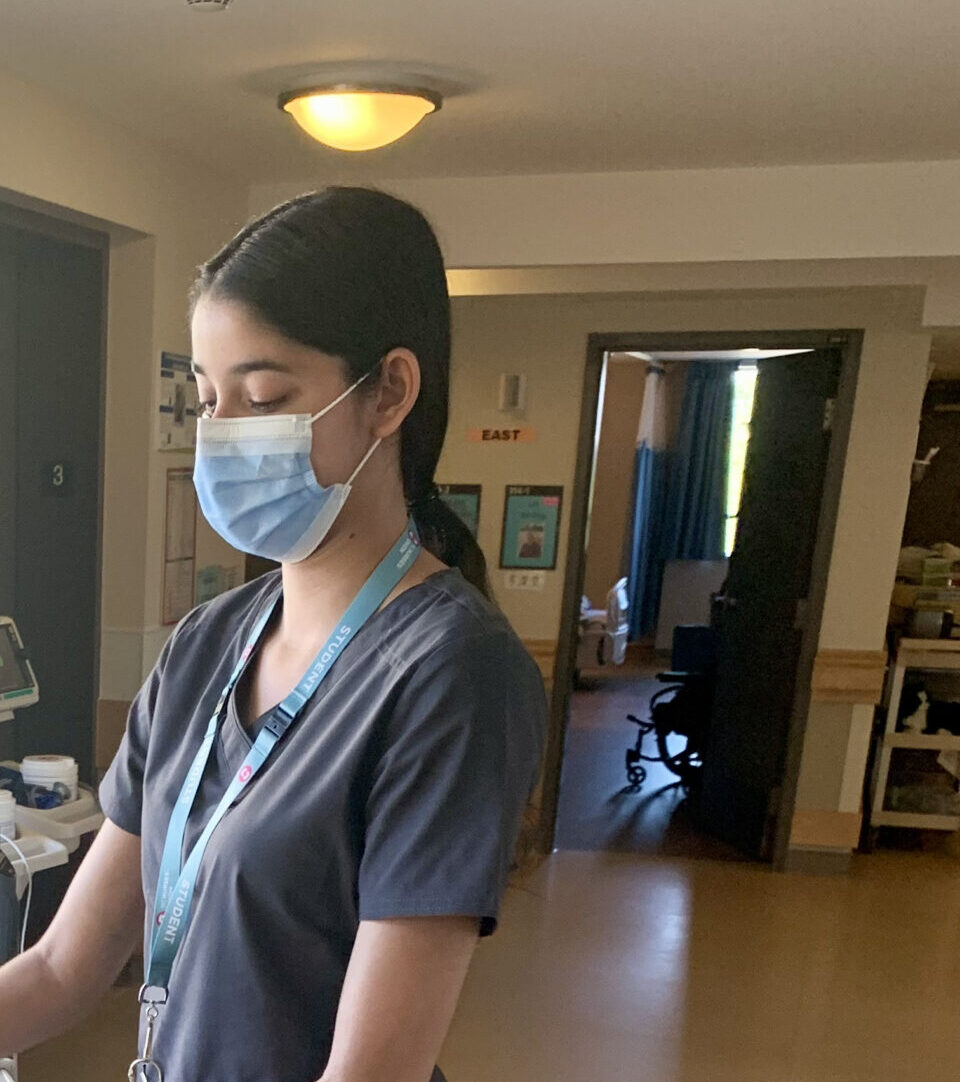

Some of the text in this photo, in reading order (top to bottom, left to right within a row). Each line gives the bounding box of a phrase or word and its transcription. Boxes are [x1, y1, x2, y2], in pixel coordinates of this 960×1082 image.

[482, 429, 520, 441] EAST
[53, 464, 64, 486] 3
[303, 625, 352, 692] STUDENT
[163, 879, 189, 945] STUDENT
